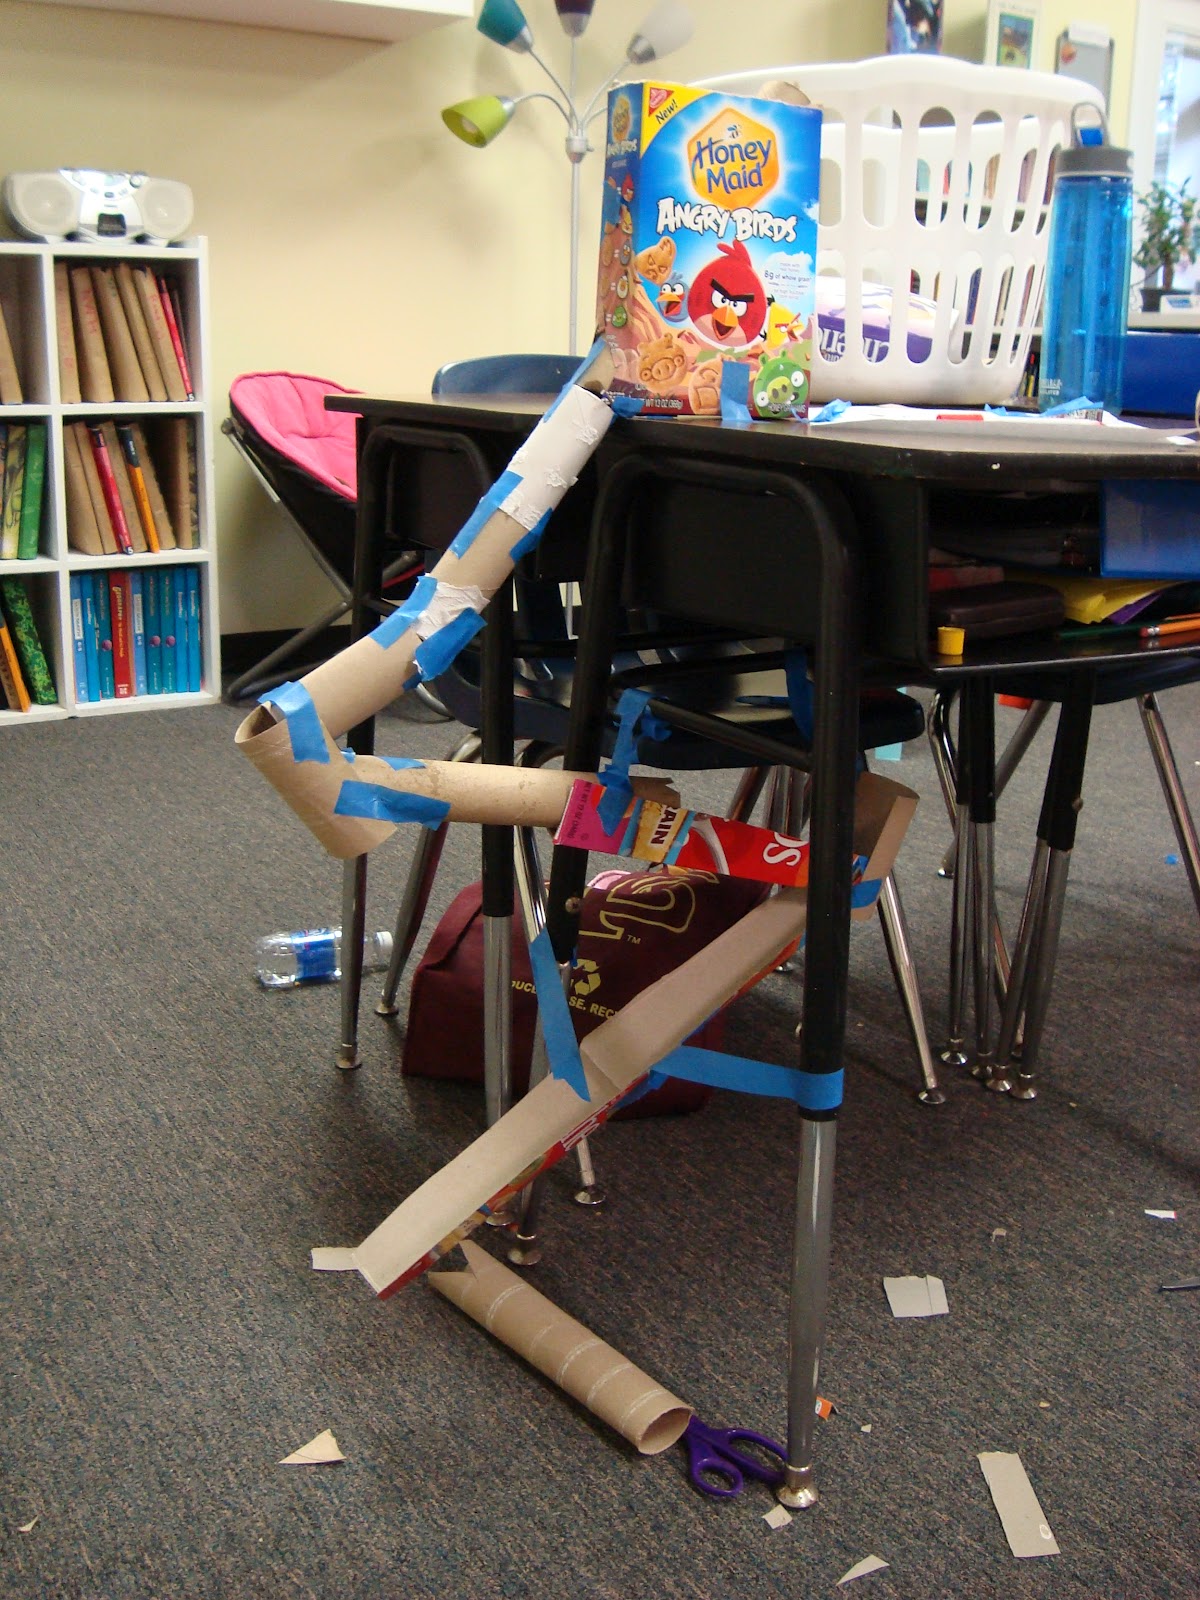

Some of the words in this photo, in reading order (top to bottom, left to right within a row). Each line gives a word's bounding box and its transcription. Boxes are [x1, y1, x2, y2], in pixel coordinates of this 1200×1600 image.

[655, 99, 678, 124] New!
[695, 137, 771, 169] Honey
[707, 162, 763, 194] Maid
[656, 196, 730, 239] ANGRY
[730, 207, 798, 243] BIRDS
[650, 804, 678, 845] AIN
[627, 934, 642, 945] TM
[589, 1003, 619, 1018] REC
